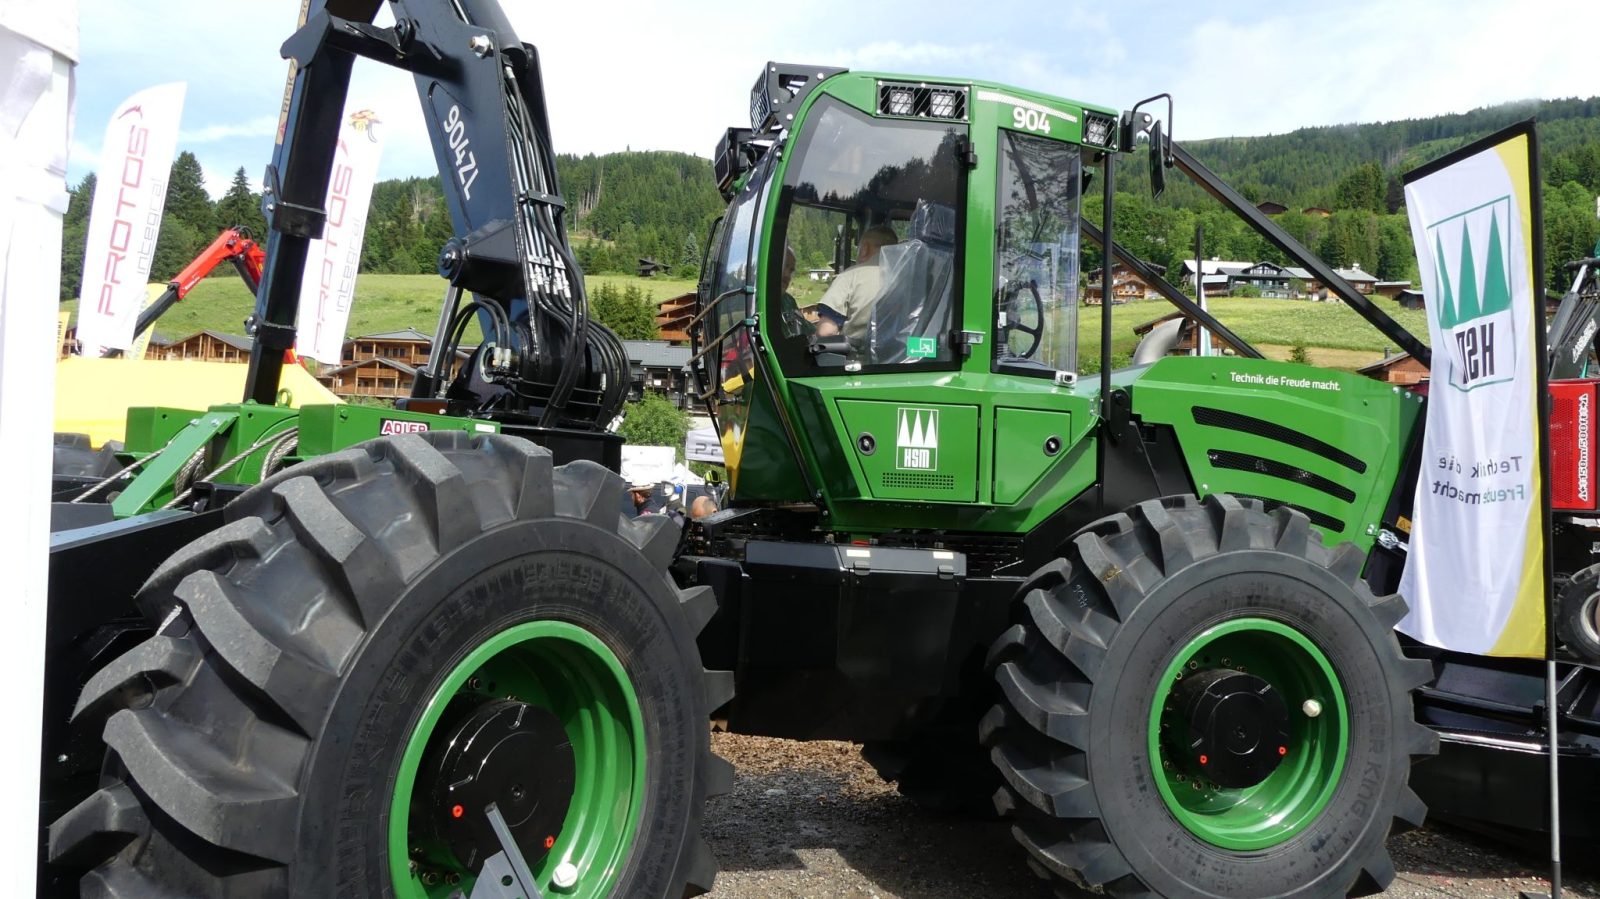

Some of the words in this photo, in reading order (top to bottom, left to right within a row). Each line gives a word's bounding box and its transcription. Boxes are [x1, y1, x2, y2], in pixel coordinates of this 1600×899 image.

[1013, 107, 1051, 134] 904
[443, 104, 479, 201] 904ZL
[98, 124, 149, 317] PROTOS
[314, 165, 353, 354] PROTOS
[1230, 372, 1264, 385] Technik
[1265, 374, 1279, 386] die
[1280, 376, 1311, 389] Freude
[1312, 378, 1341, 391] macht.
[904, 448, 930, 469] HSM
